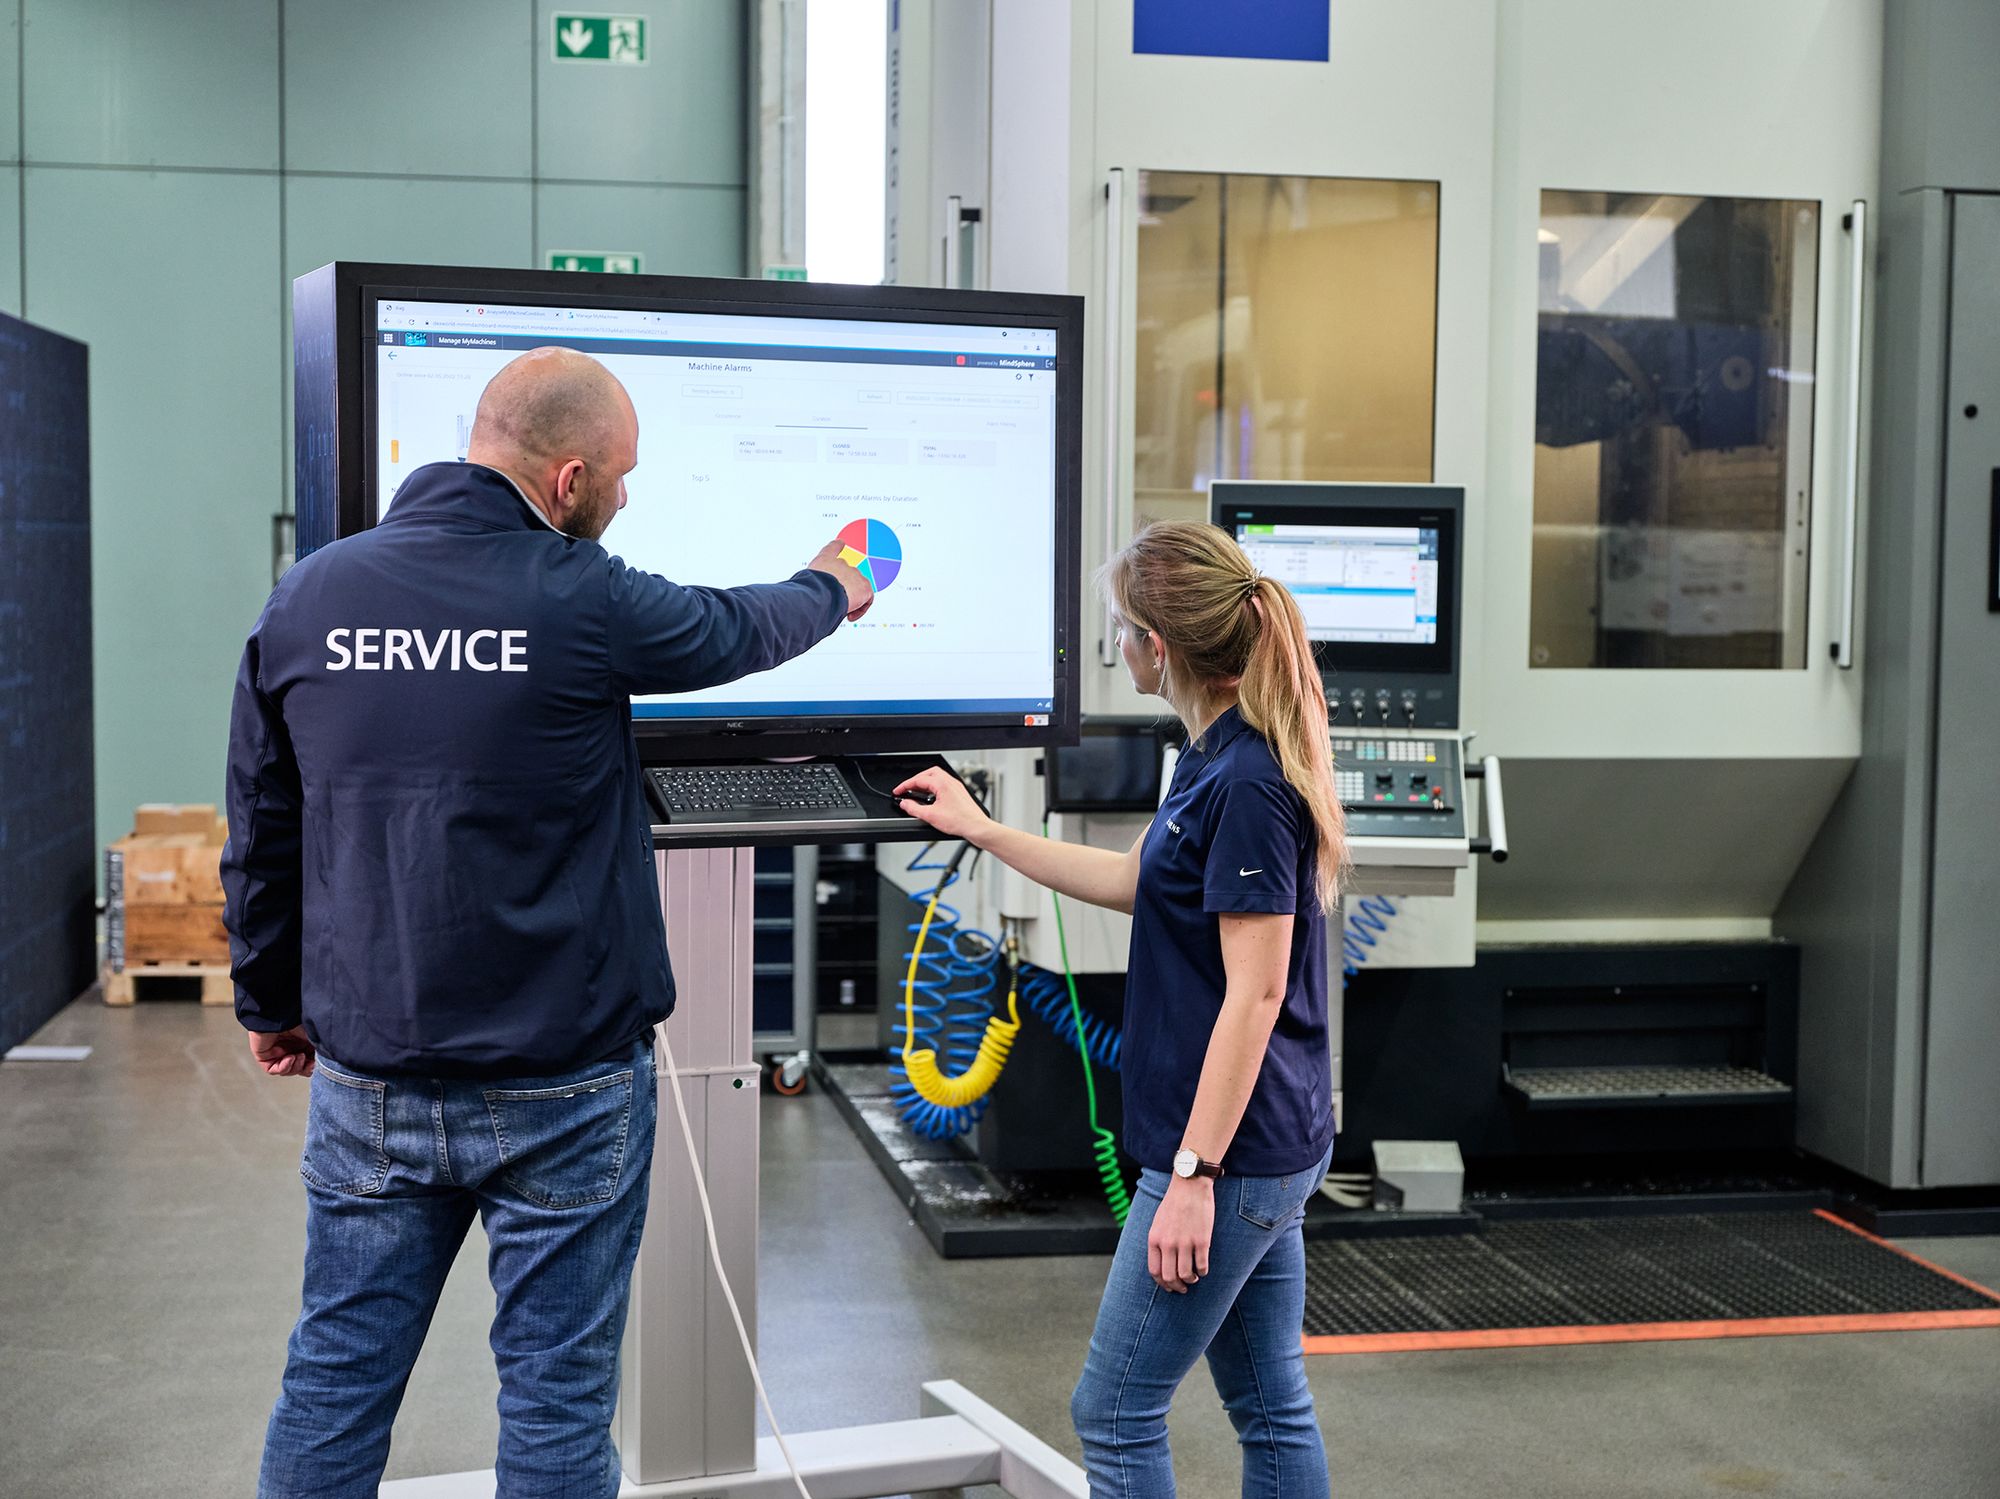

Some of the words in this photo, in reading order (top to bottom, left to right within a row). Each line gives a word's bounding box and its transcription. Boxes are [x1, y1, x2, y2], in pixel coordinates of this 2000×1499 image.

[438, 336, 461, 346] Manage
[462, 337, 497, 346] MyMachines
[688, 362, 723, 372] Machine
[724, 363, 752, 373] Alarms
[999, 359, 1036, 369] MindSphere
[325, 627, 528, 672] SERVICE
[727, 721, 744, 729] NEC
